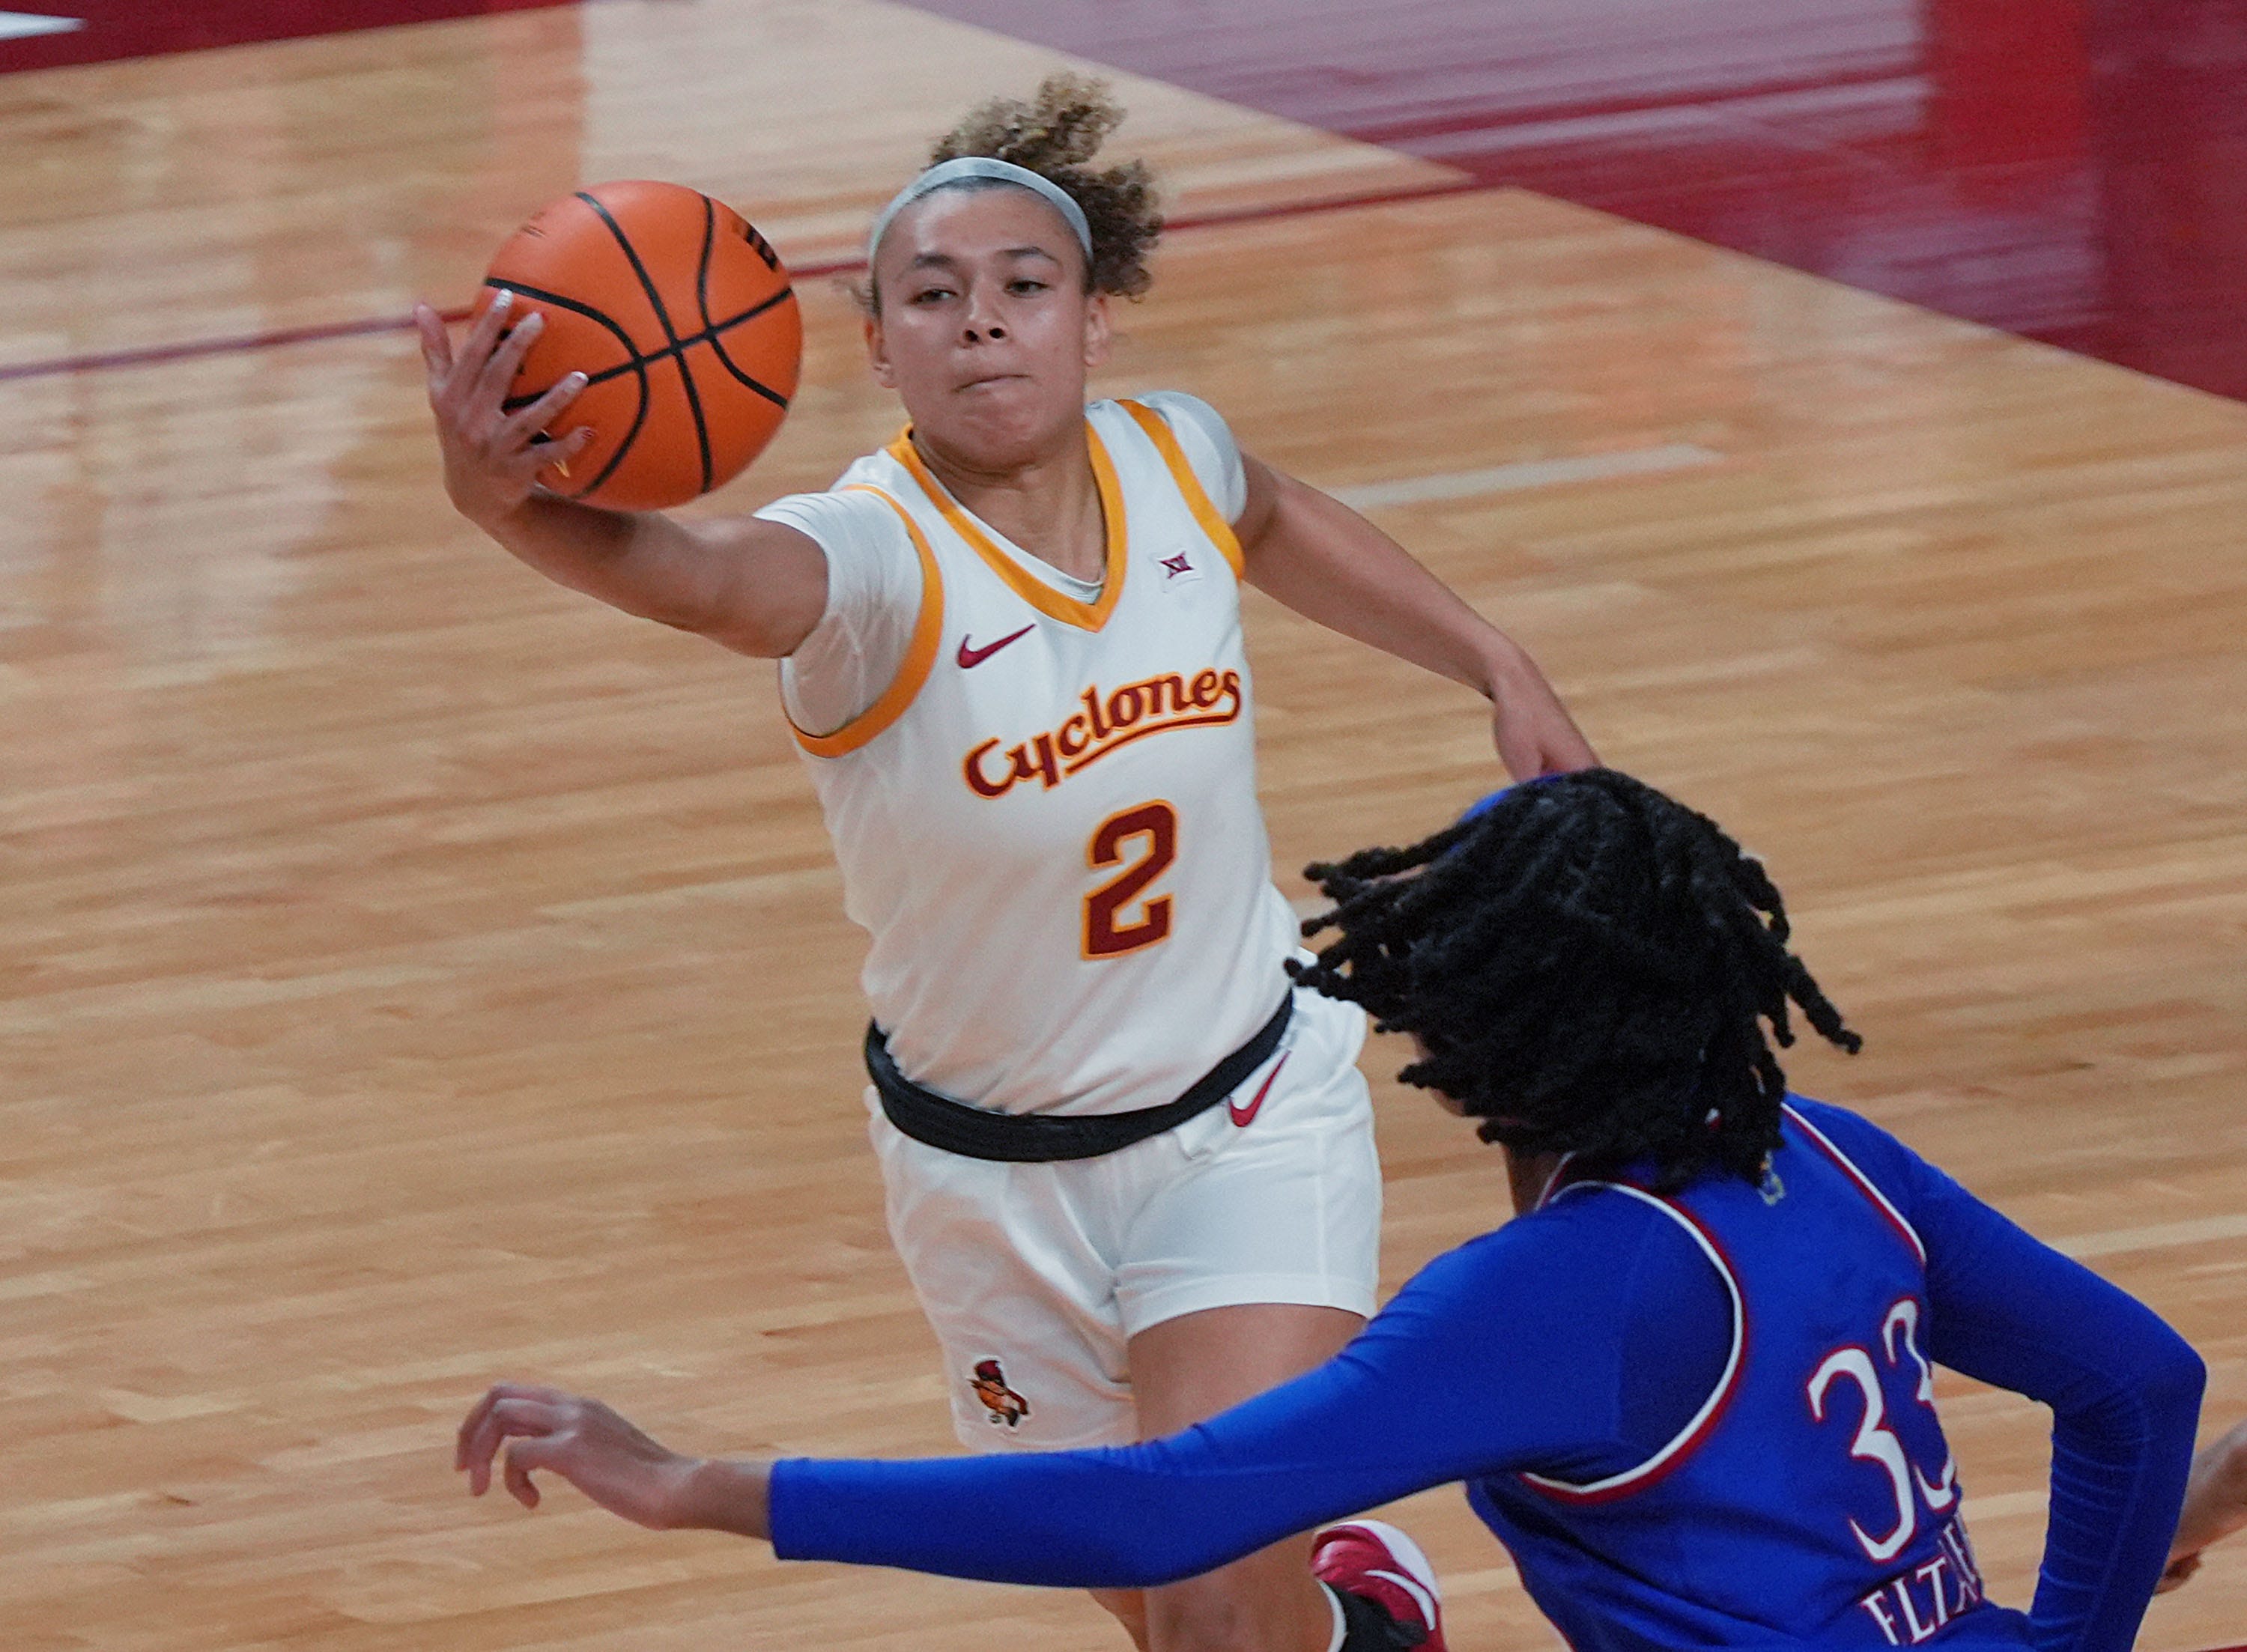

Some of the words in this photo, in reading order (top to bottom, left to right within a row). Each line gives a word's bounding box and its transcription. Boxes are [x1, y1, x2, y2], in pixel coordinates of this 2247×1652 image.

[962, 666, 1241, 798] Cyclones
[1081, 798, 1177, 961] 2
[1805, 1295, 1958, 1562] 33
